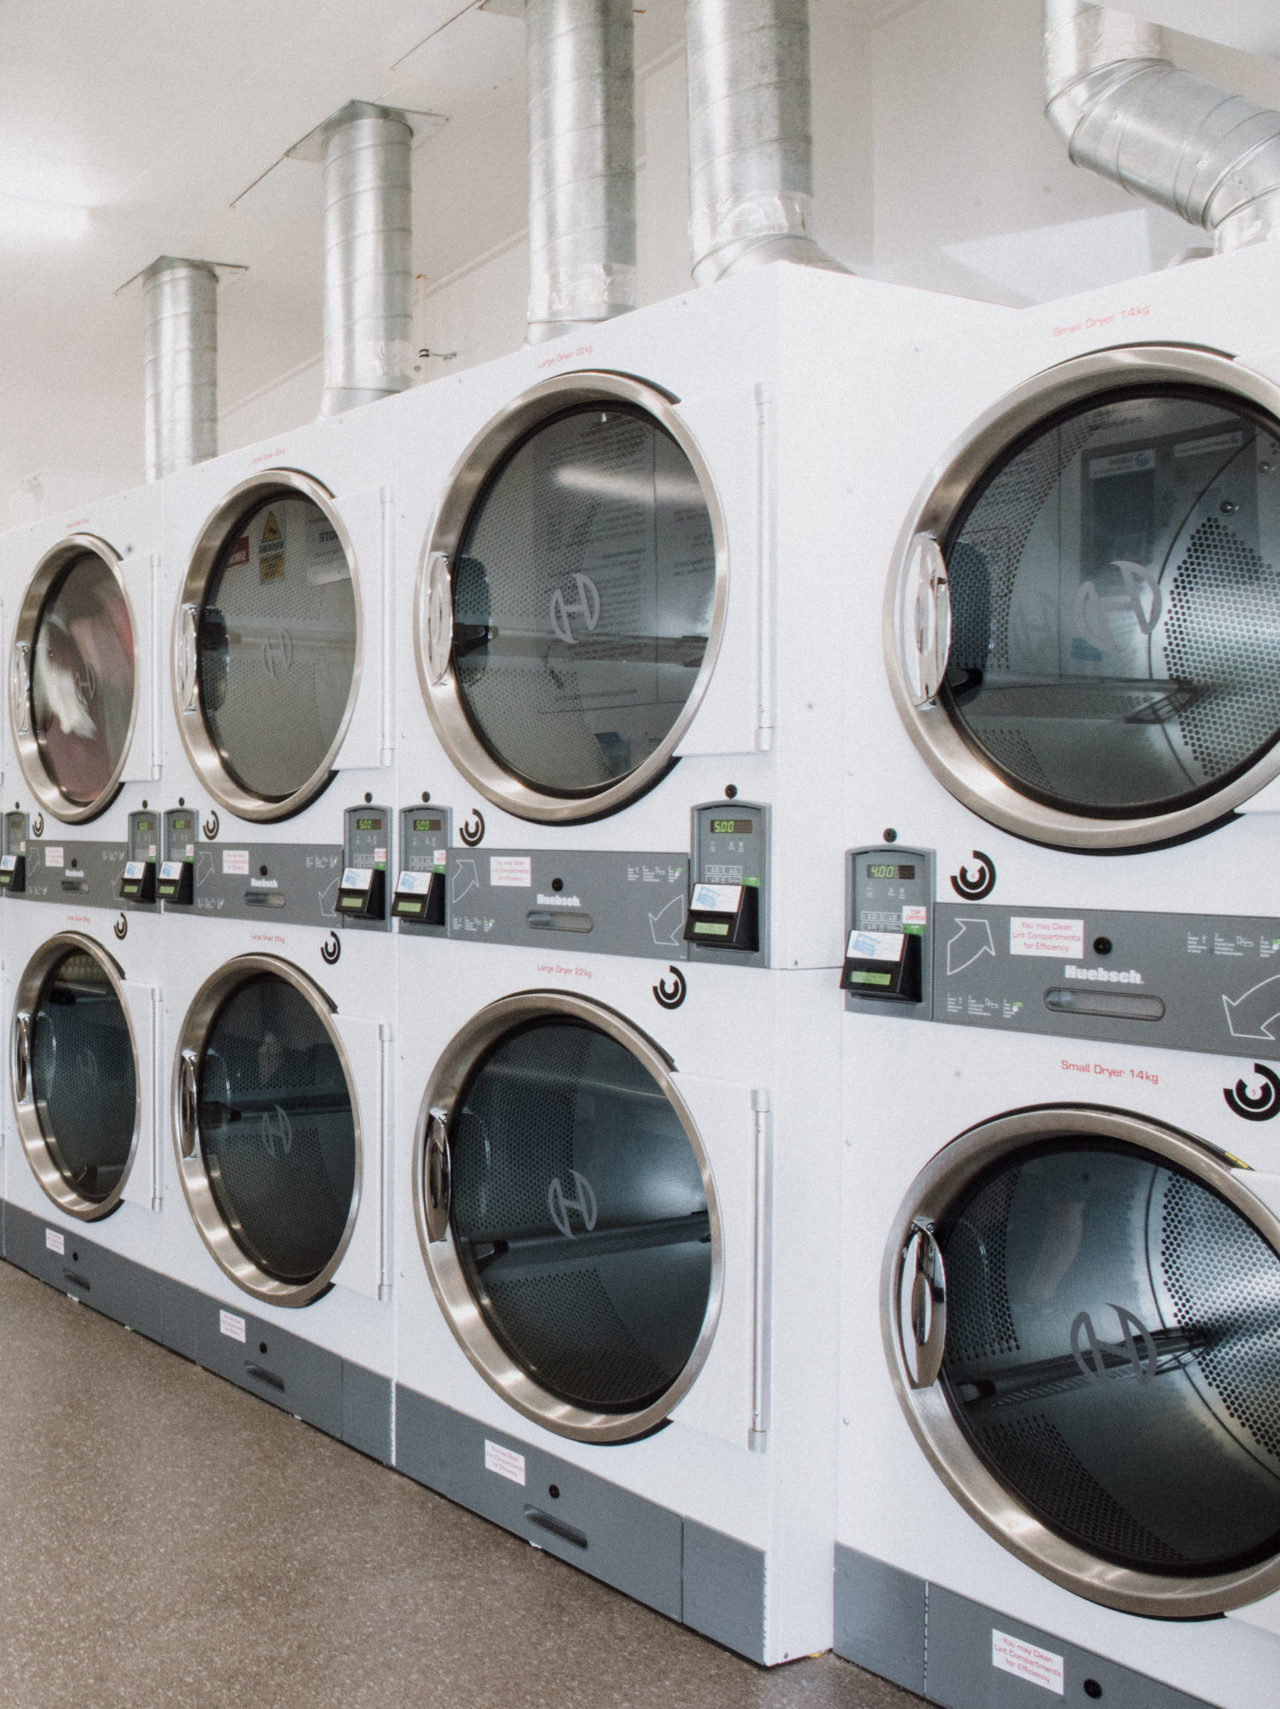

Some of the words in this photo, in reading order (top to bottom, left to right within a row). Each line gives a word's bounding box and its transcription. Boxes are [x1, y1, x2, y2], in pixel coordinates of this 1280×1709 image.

[1053, 321, 1082, 337] Small
[1085, 313, 1116, 328] Dryer
[1121, 305, 1150, 319] 14kg
[1021, 921, 1034, 930] You
[1035, 923, 1050, 932] may
[1052, 922, 1072, 931] Clean
[1027, 931, 1081, 942] Compartments
[1064, 964, 1142, 984] Huebsch
[1060, 1059, 1091, 1074] Small
[1094, 1063, 1124, 1079] Dryer
[1129, 1069, 1159, 1085] 14kg
[1009, 1649, 1062, 1678] Compartments
[1033, 1649, 1054, 1664] Clean
